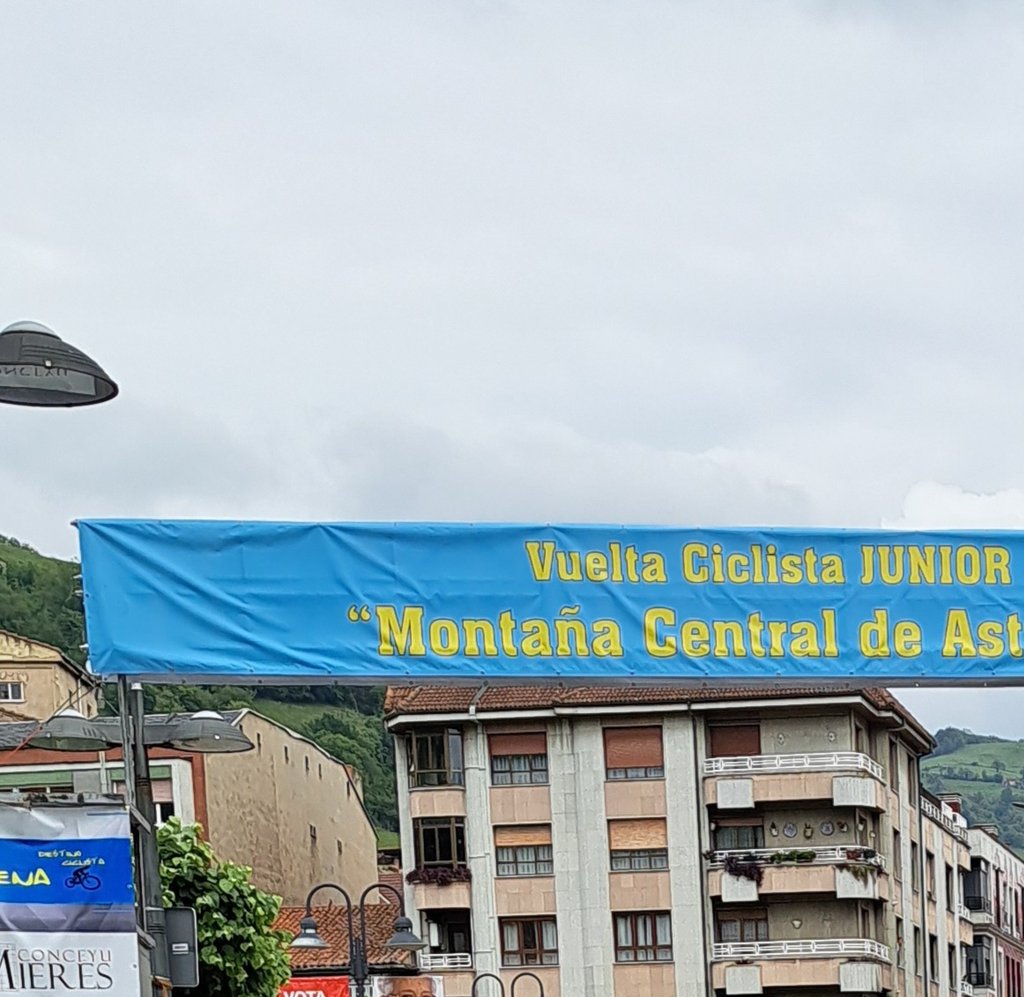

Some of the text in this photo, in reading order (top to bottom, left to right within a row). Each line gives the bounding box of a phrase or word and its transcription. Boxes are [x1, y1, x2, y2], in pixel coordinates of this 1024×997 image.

[525, 541, 1012, 585] Vuelta Ciclista JUNIOR
[347, 605, 624, 657] “Montaña
[644, 608, 839, 658] Central
[859, 609, 922, 658] de
[17, 948, 112, 962] CONCEYU
